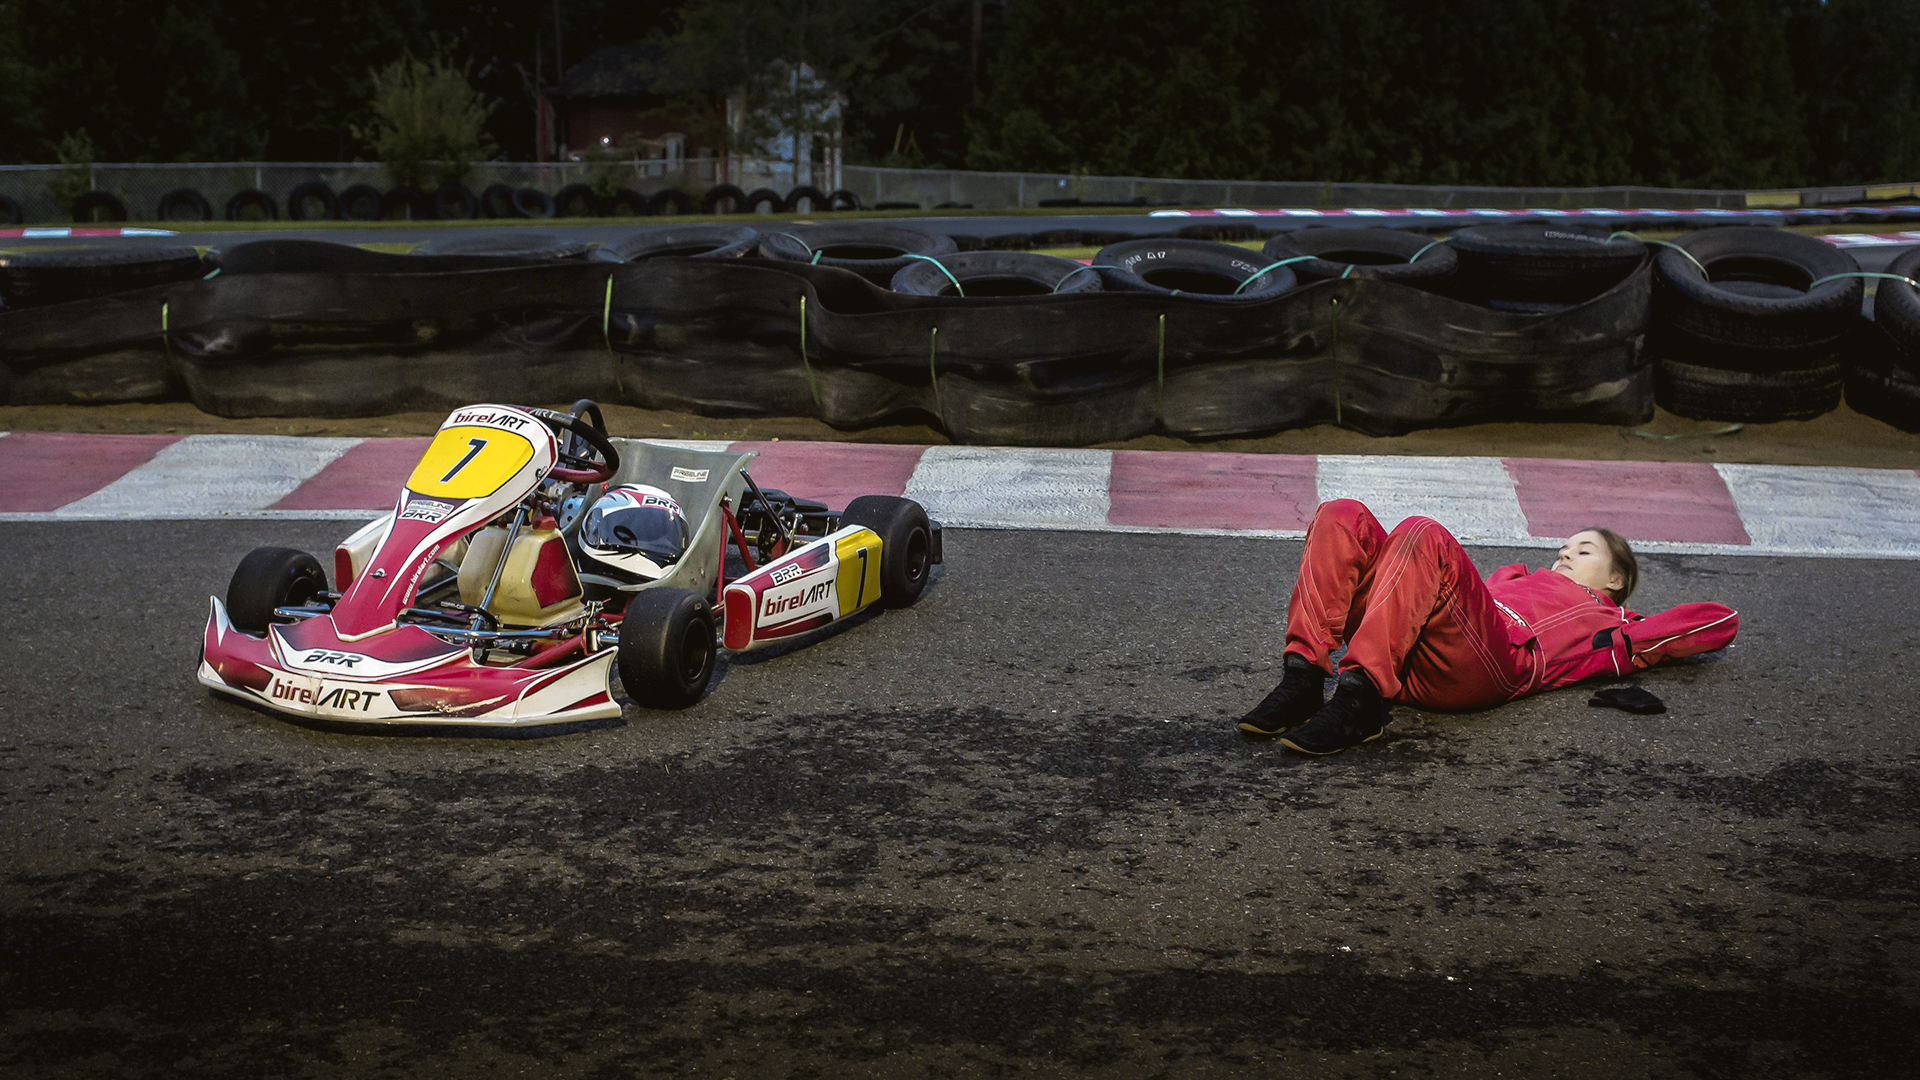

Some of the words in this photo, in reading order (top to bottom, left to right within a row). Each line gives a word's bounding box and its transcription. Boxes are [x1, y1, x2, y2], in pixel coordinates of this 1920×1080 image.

[453, 412, 530, 430] birelART
[645, 496, 679, 513] BRR
[401, 509, 442, 522] BRR
[402, 543, 441, 605] www.birelart.com
[772, 564, 801, 584] BRR
[764, 579, 835, 617] birelART
[303, 650, 365, 668] BRR
[272, 678, 381, 712] birelART
